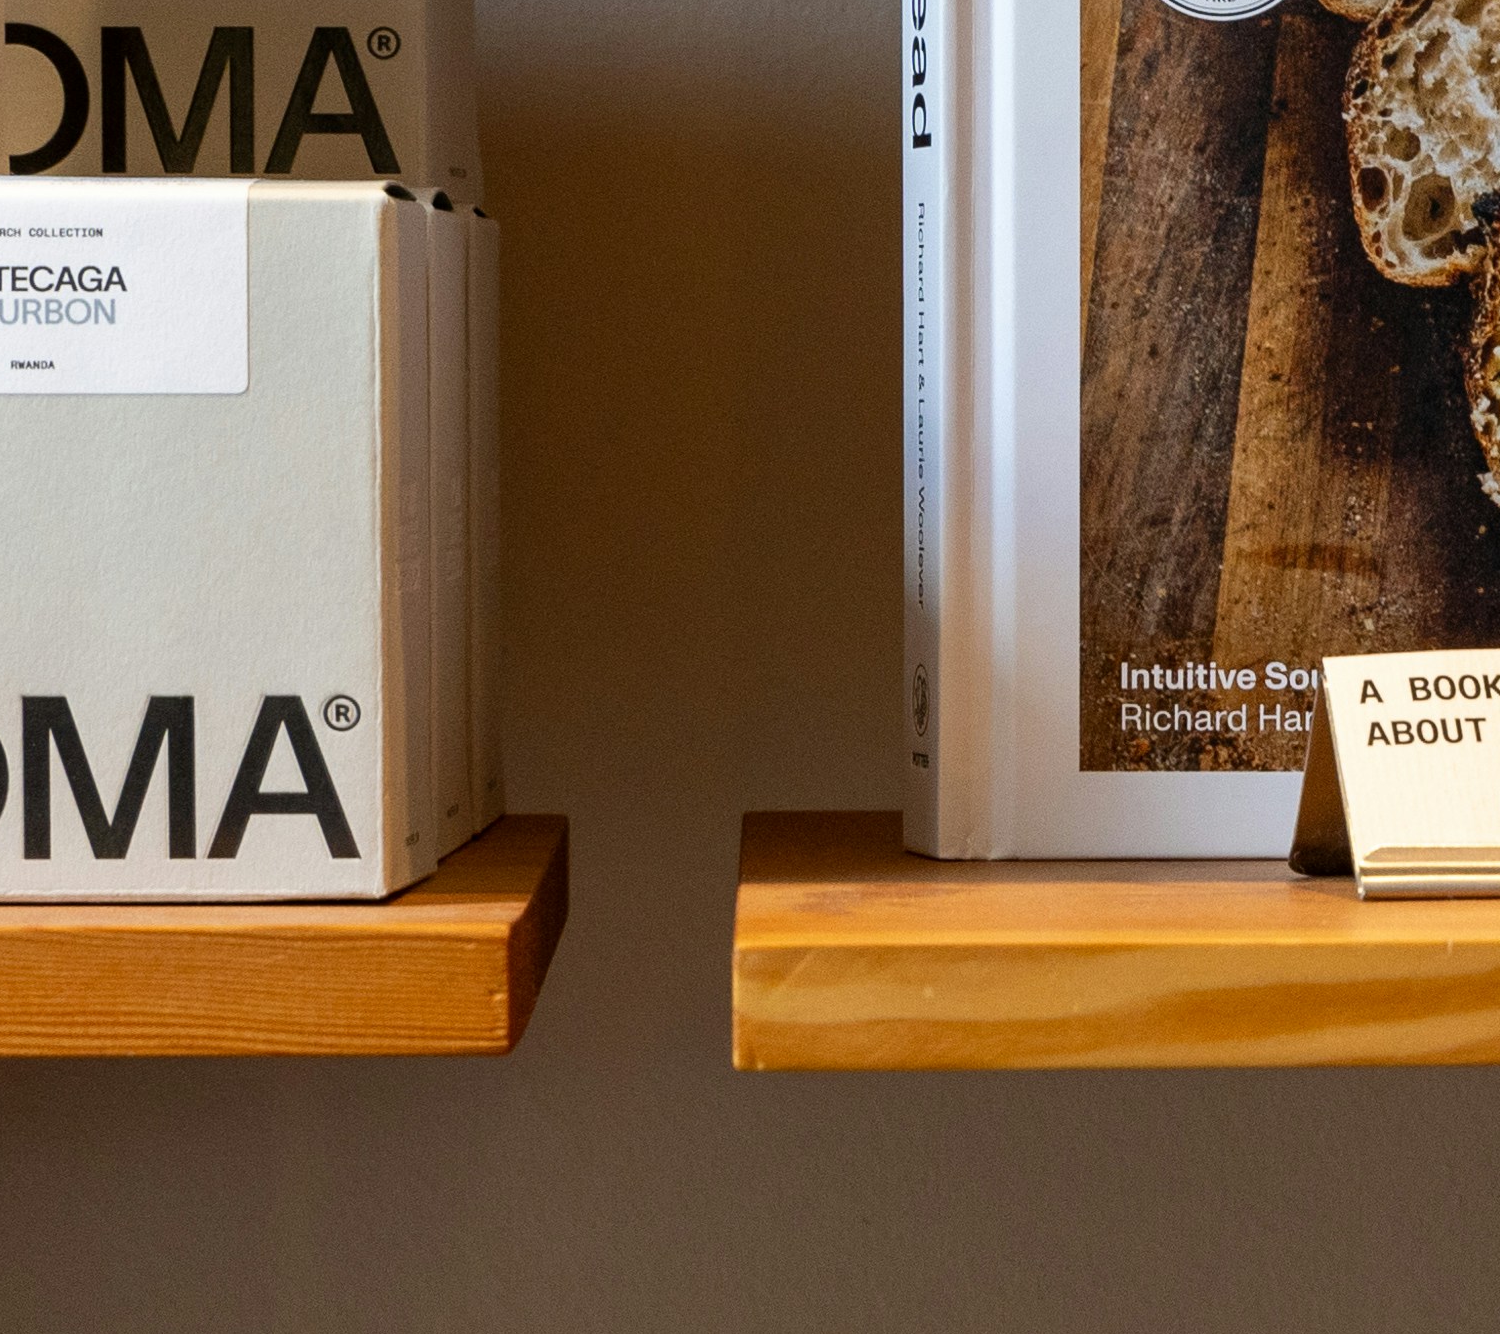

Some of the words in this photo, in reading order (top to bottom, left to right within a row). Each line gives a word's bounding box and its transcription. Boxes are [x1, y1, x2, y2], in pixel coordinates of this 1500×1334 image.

[28, 227, 104, 238] COLLECTION
[917, 202, 926, 303] Richard
[917, 311, 926, 365] Hart
[10, 360, 55, 370] RWANDA
[917, 398, 926, 480] Laurie
[917, 486, 926, 610] Woolever
[1121, 661, 1257, 690] Intuitive
[1360, 679, 1384, 704] A
[1121, 703, 1247, 733] Richard
[1367, 717, 1486, 746] ABOUT
